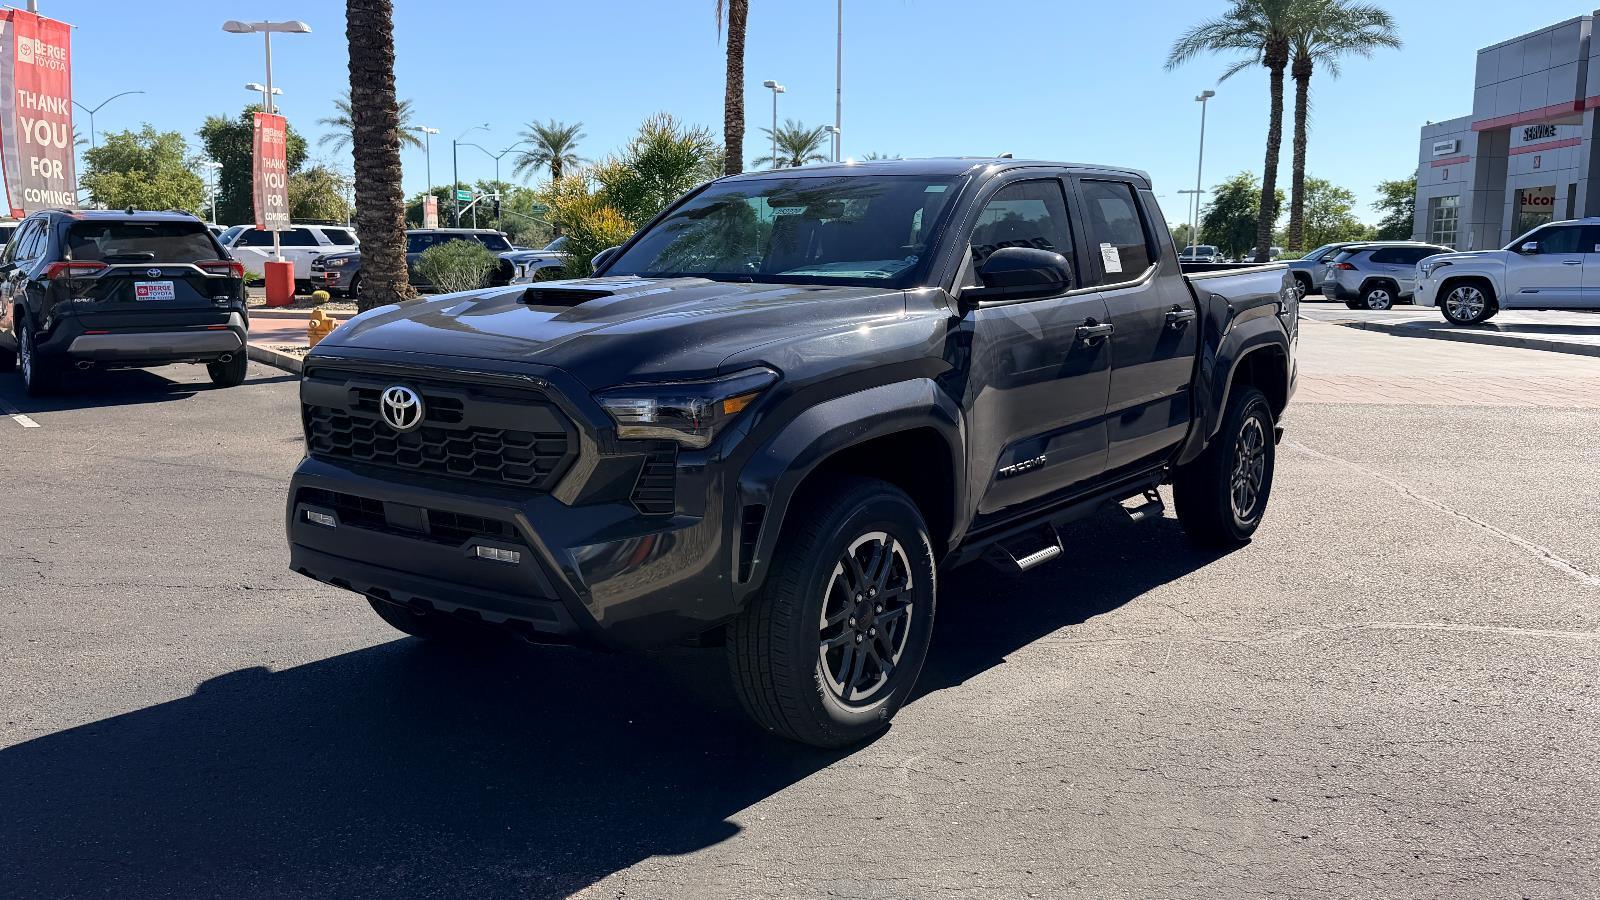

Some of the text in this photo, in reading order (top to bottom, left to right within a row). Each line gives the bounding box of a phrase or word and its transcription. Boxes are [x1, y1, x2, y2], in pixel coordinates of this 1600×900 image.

[34, 39, 66, 60] BERGE
[35, 56, 66, 72] TOYOTA
[18, 89, 69, 116] THANK
[20, 116, 67, 149] YOU
[1523, 125, 1557, 141] SERVICE
[30, 156, 64, 180] FOR
[262, 158, 285, 170] THANK
[263, 173, 284, 189] YOU
[24, 188, 76, 206] COMING!
[267, 194, 283, 207] FOR
[265, 212, 289, 221] COMING!
[999, 454, 1047, 477] TACOMA
